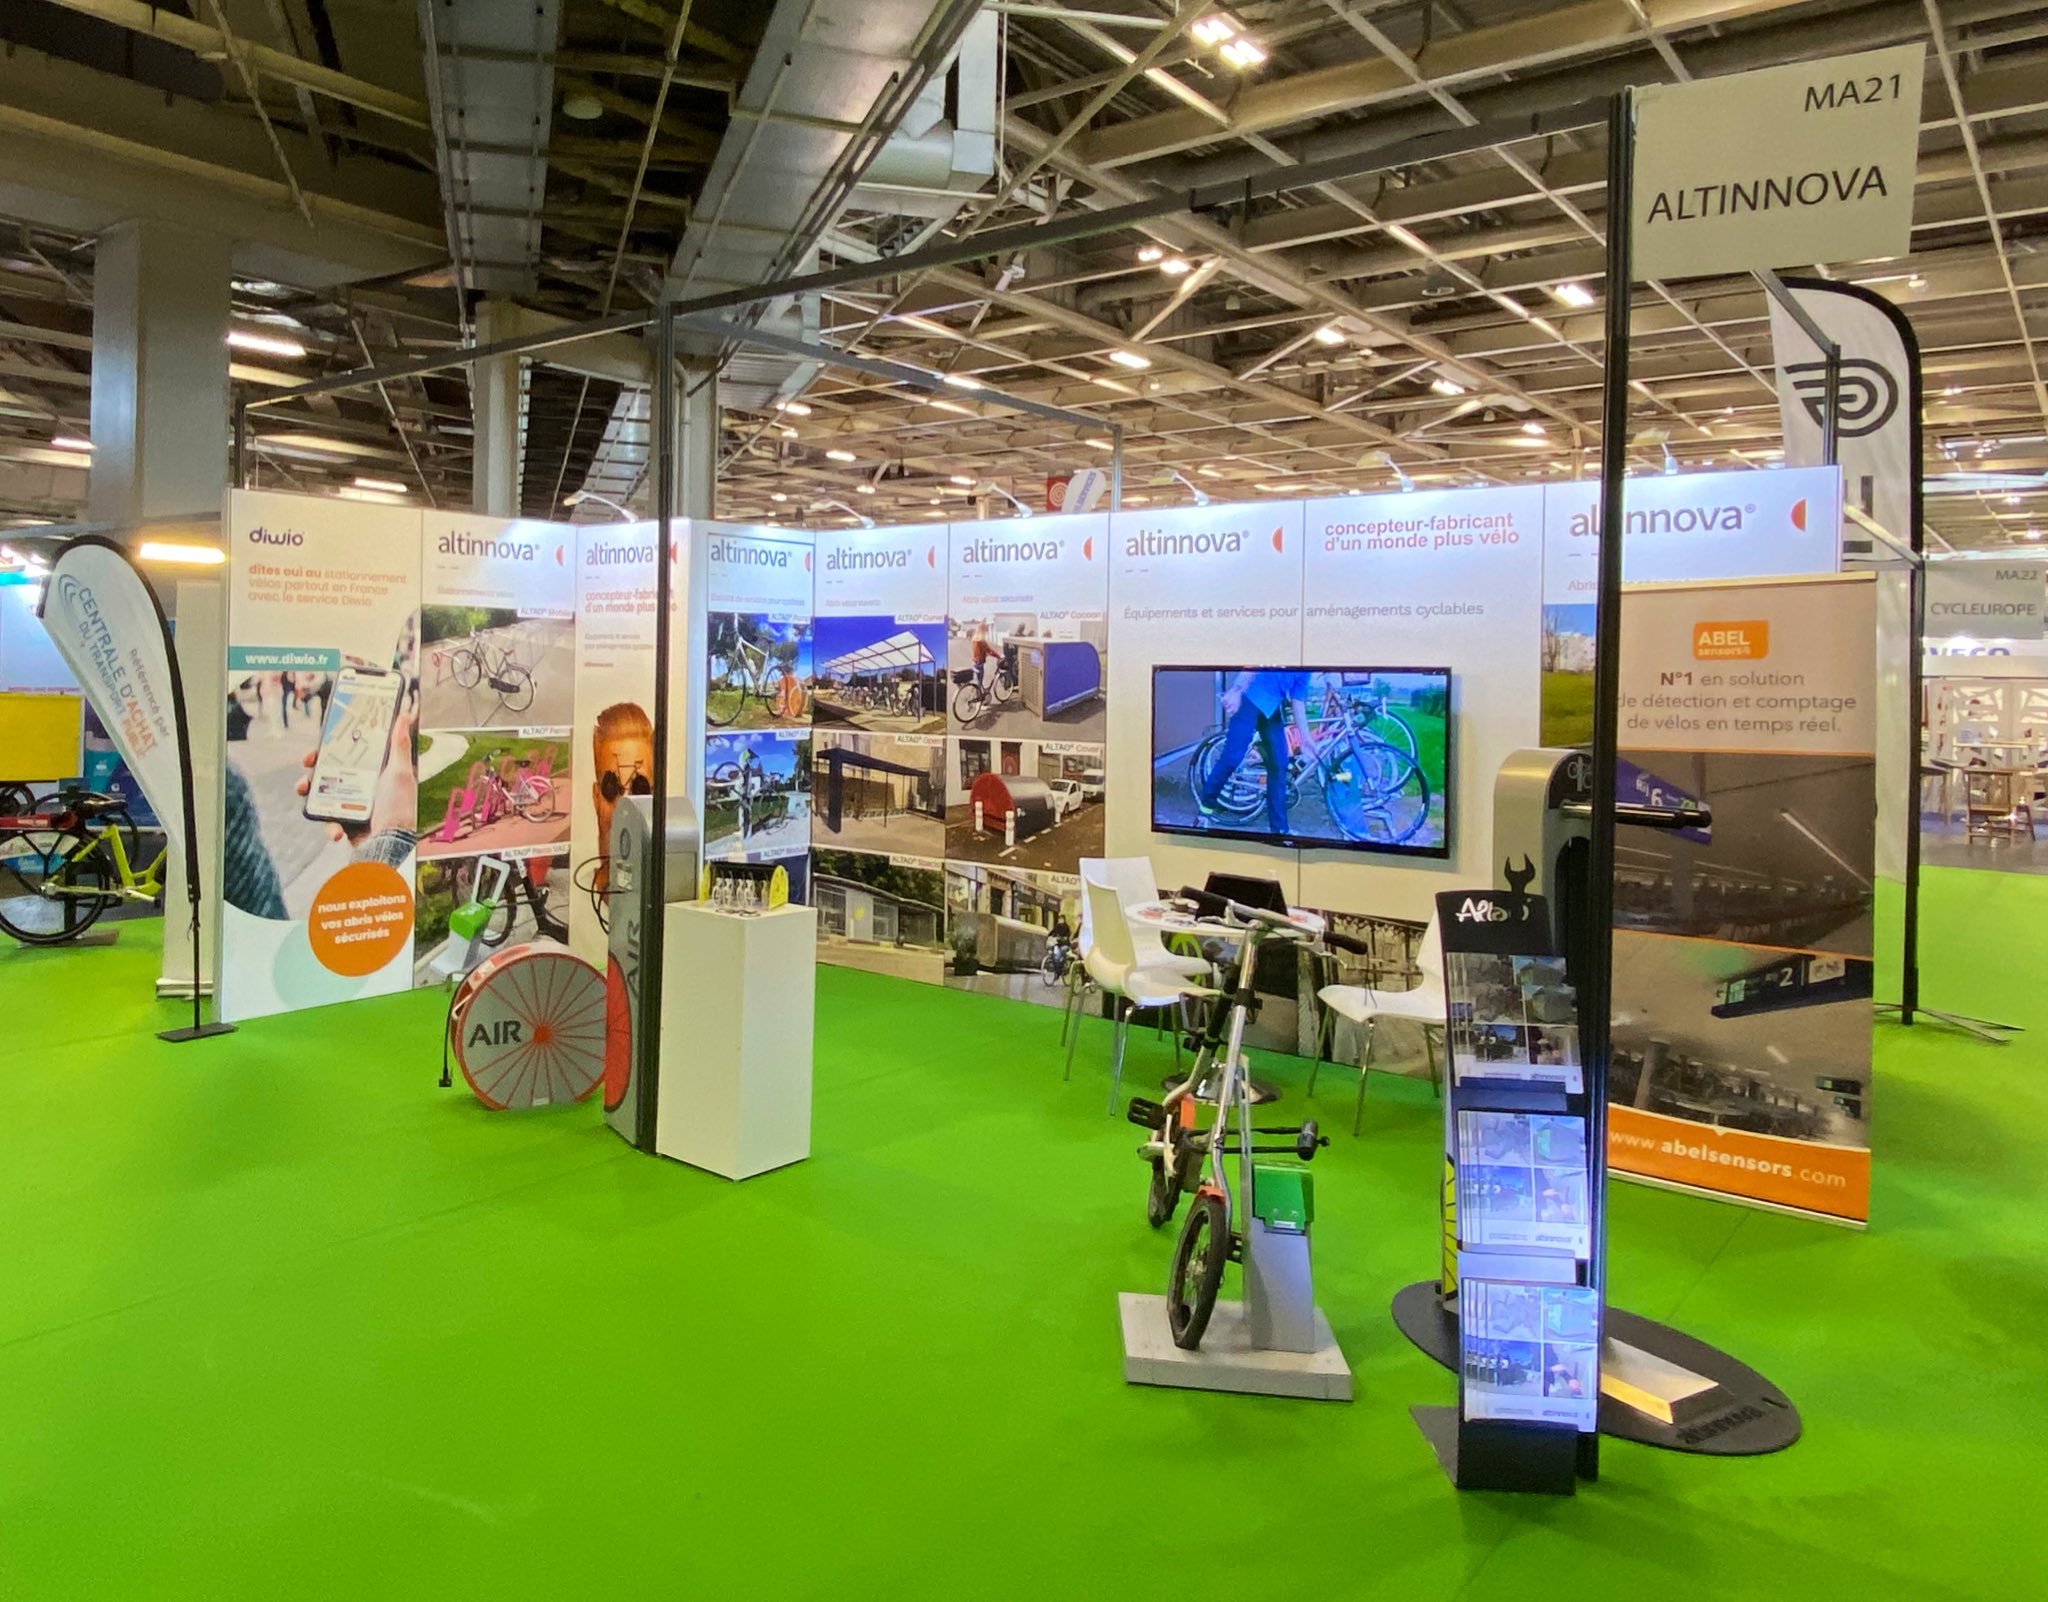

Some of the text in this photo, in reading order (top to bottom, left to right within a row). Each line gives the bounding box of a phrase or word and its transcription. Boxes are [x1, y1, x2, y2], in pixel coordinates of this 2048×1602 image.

[1804, 74, 1900, 112] MA21
[1647, 165, 1888, 223] ALTINNOVA
[1325, 513, 1514, 536] concepteur-fabricant
[249, 527, 304, 546] diwio
[1367, 534, 1428, 550] monde
[1434, 531, 1473, 550] plus
[1479, 529, 1519, 545] vélo
[249, 564, 407, 584] dites oui au stationnement
[1996, 570, 2038, 580] MA22
[249, 577, 389, 596] vélos partout en France
[248, 591, 373, 607] avec le service Diwio
[605, 602, 634, 613] monde
[636, 602, 656, 615] plus
[1124, 601, 1484, 621] Équipements et services pour aménagements cyclables
[1930, 602, 2037, 616] CYCLEUROPE
[79, 622, 94, 639] DU
[79, 587, 126, 682] CENTRALE
[1698, 630, 1751, 646] ABEL
[245, 653, 329, 665] www.diwio.fr
[88, 643, 126, 715] TRANSPORT
[1660, 671, 1804, 686] N°1 en solution
[1642, 691, 1727, 709] détection
[1732, 694, 1751, 709] et
[1756, 694, 1857, 713] comptage
[1627, 713, 1842, 735] de vélos en temps réel.
[318, 895, 407, 914] nous exploitons
[321, 911, 404, 930] vos abris vélos
[335, 928, 390, 944] sécurisés
[1779, 967, 1794, 987] 2
[468, 1020, 522, 1048] AIR
